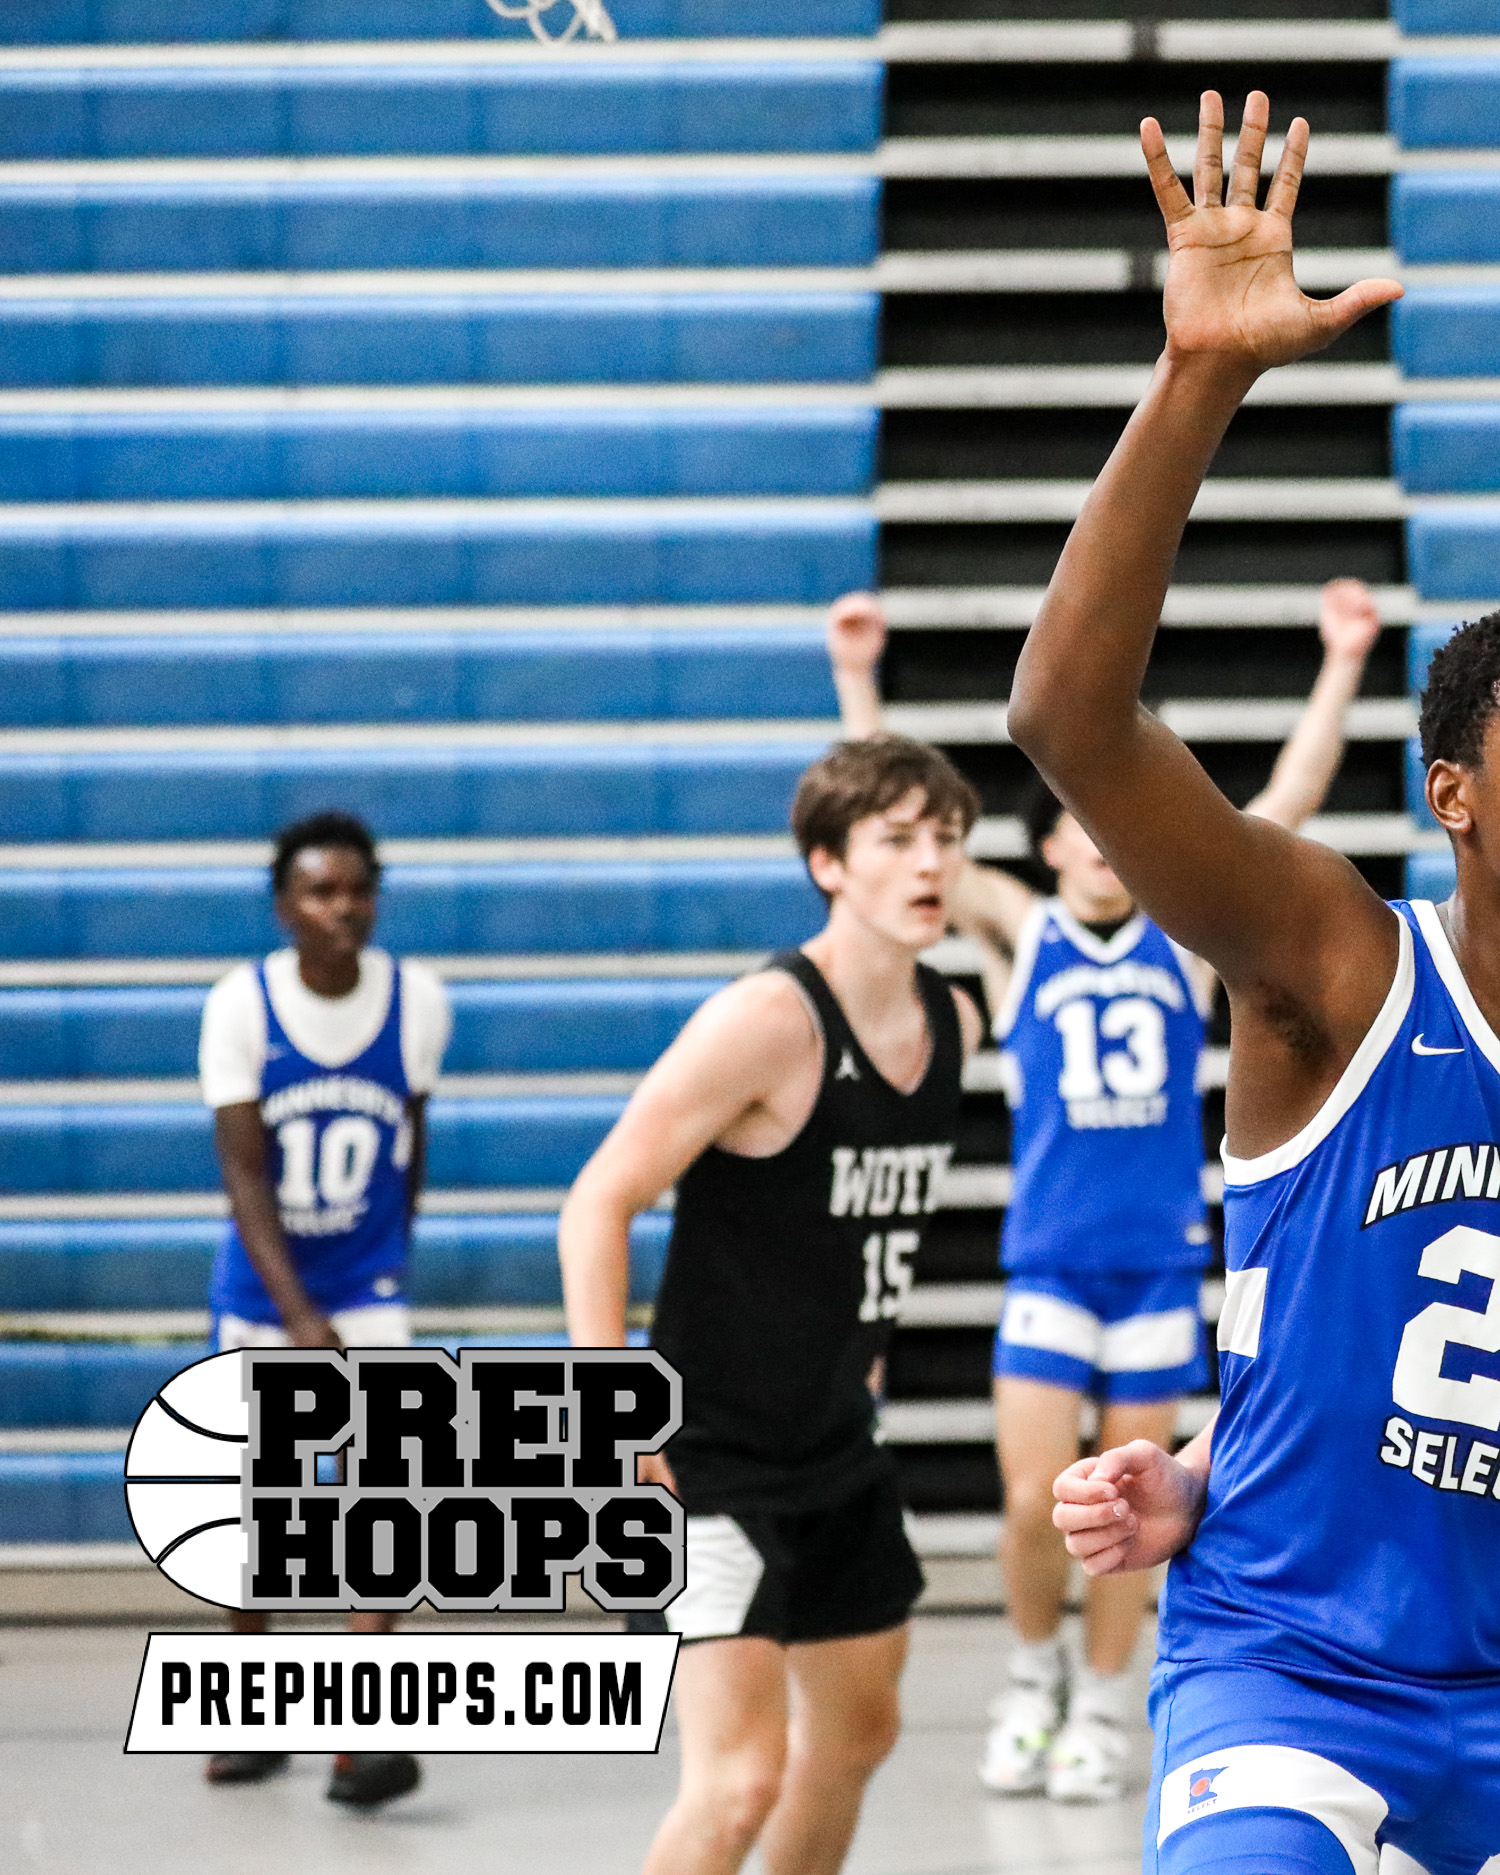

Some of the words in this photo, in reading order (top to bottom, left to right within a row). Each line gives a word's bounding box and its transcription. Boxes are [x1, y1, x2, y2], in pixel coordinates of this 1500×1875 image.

[1054, 998, 1168, 1099] 13
[276, 1114, 381, 1206] 10
[858, 1231, 920, 1321] 15
